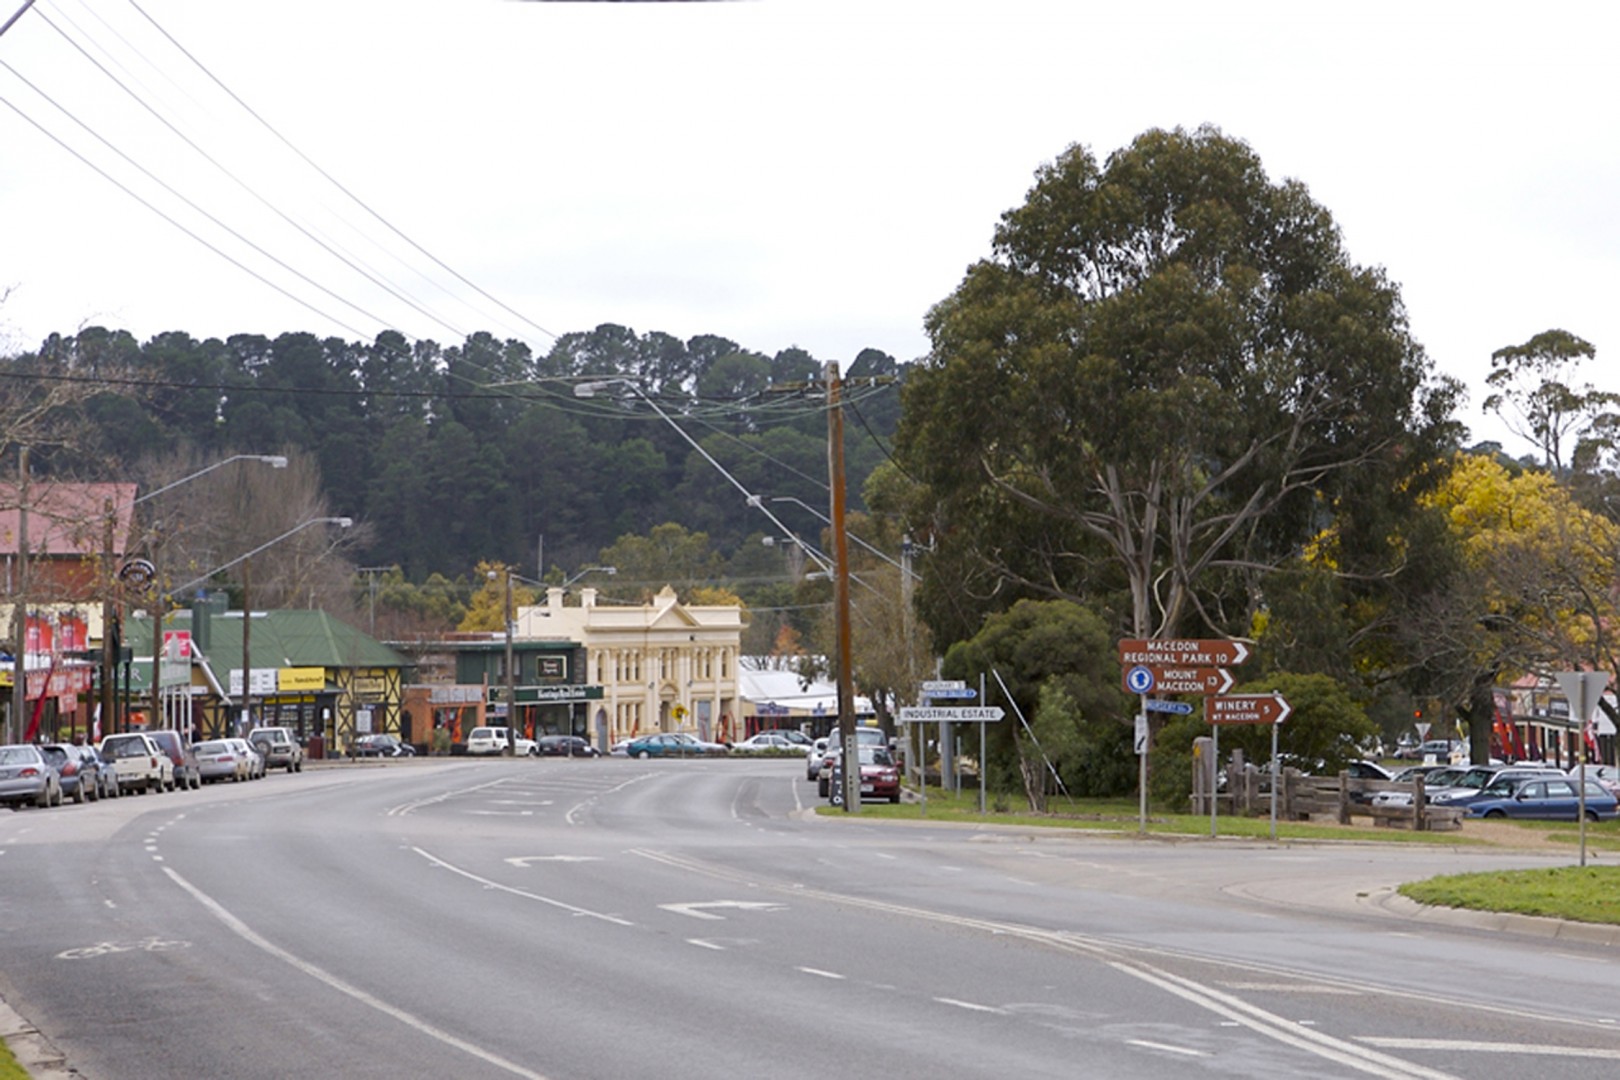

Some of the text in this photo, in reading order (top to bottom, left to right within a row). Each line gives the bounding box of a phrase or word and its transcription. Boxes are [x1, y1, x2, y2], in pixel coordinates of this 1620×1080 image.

[1146, 641, 1199, 651] MACEDON
[1123, 652, 1228, 664] REGIONAL PARK 10
[1163, 670, 1198, 679] MOUNT
[1156, 681, 1205, 692] MACEDON
[1214, 701, 1257, 711] WINERY
[904, 708, 996, 719] INDUSTRIAL ESTATE
[1212, 712, 1260, 721] MT MACEDON
